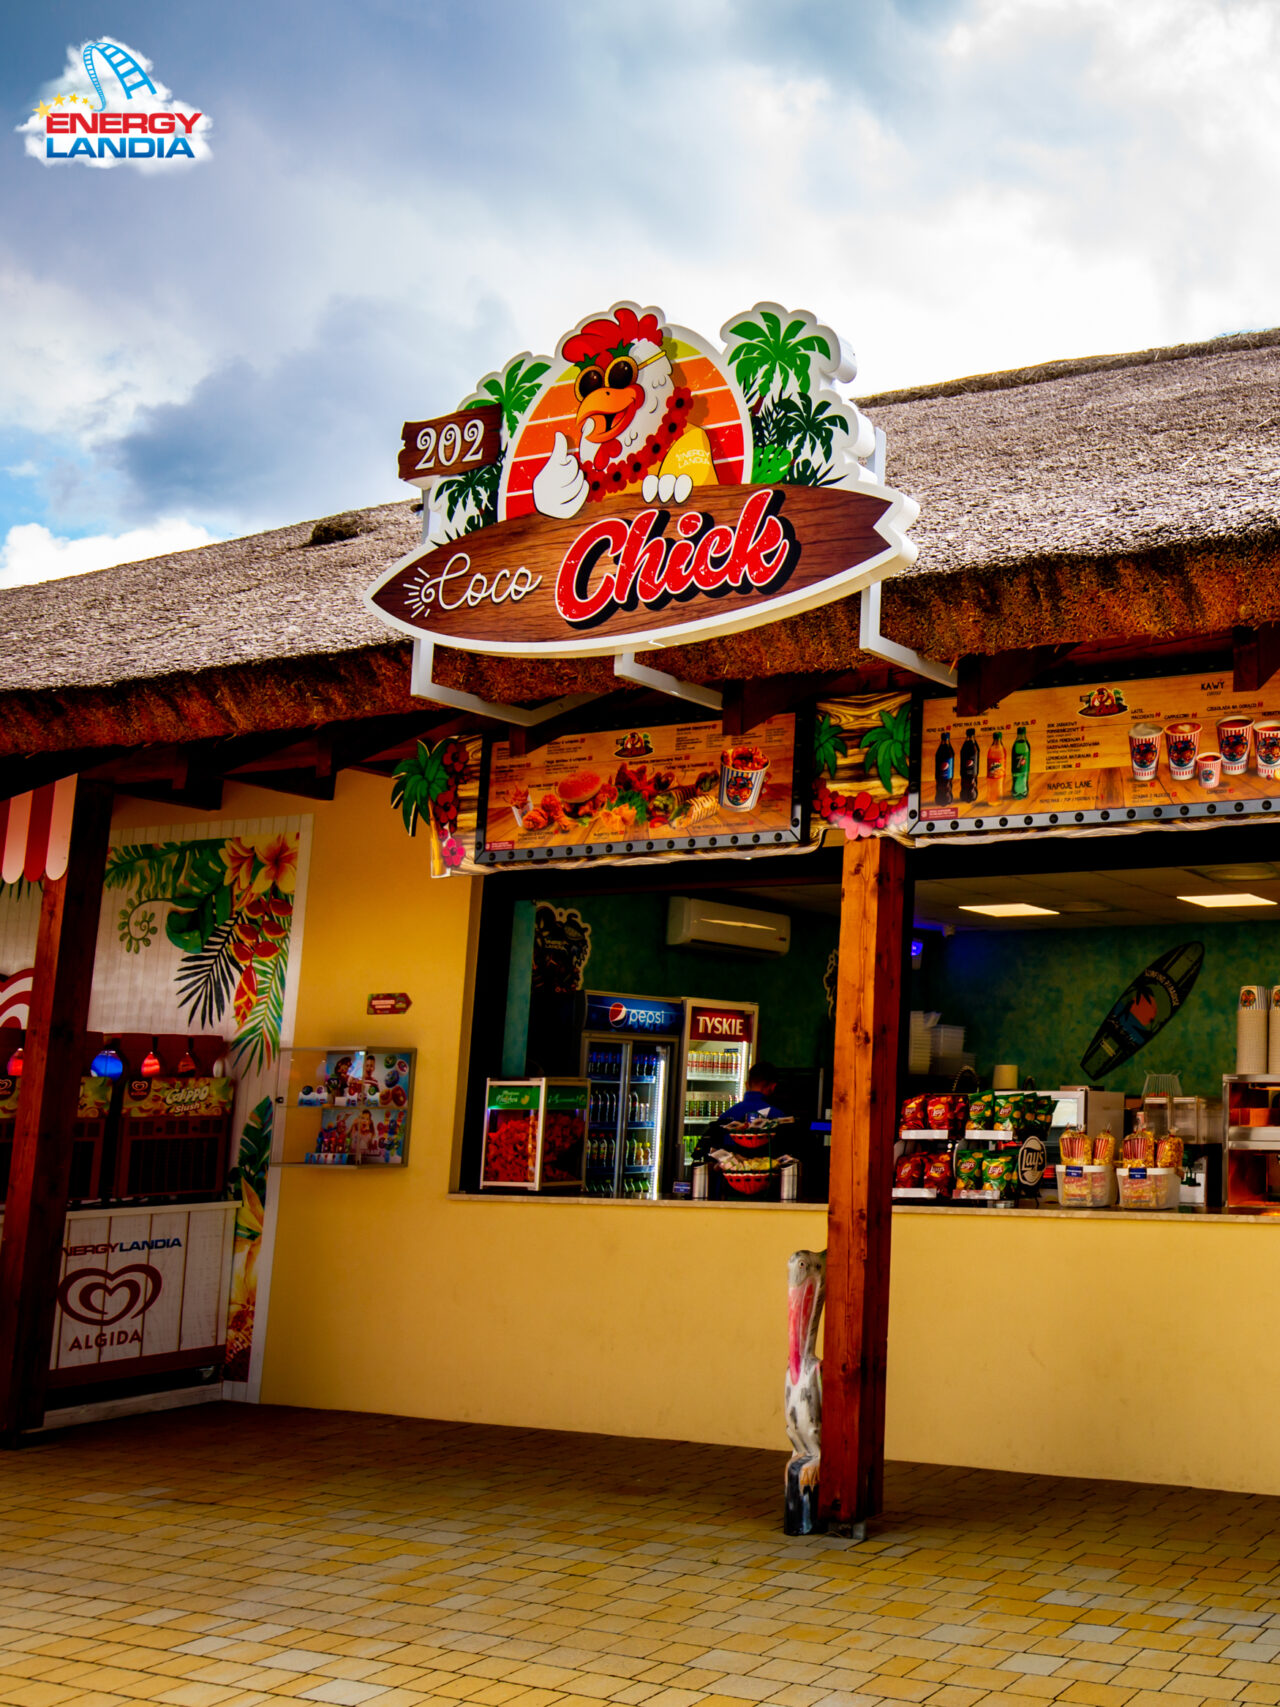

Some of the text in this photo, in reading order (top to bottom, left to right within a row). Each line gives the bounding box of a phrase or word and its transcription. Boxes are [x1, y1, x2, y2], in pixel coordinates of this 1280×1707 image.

[415, 419, 485, 470] 202
[421, 489, 792, 624] Coco Chick
[1201, 681, 1225, 691] KAWY
[1047, 781, 1072, 790] NAPOJE
[628, 1010, 665, 1026] pepsi
[697, 1016, 744, 1035] TYSKIE
[166, 1086, 209, 1104] Calippo
[174, 1102, 200, 1113] Slush
[62, 1237, 182, 1256] NERGYLANDIA
[69, 1329, 142, 1352] ALGIDA
